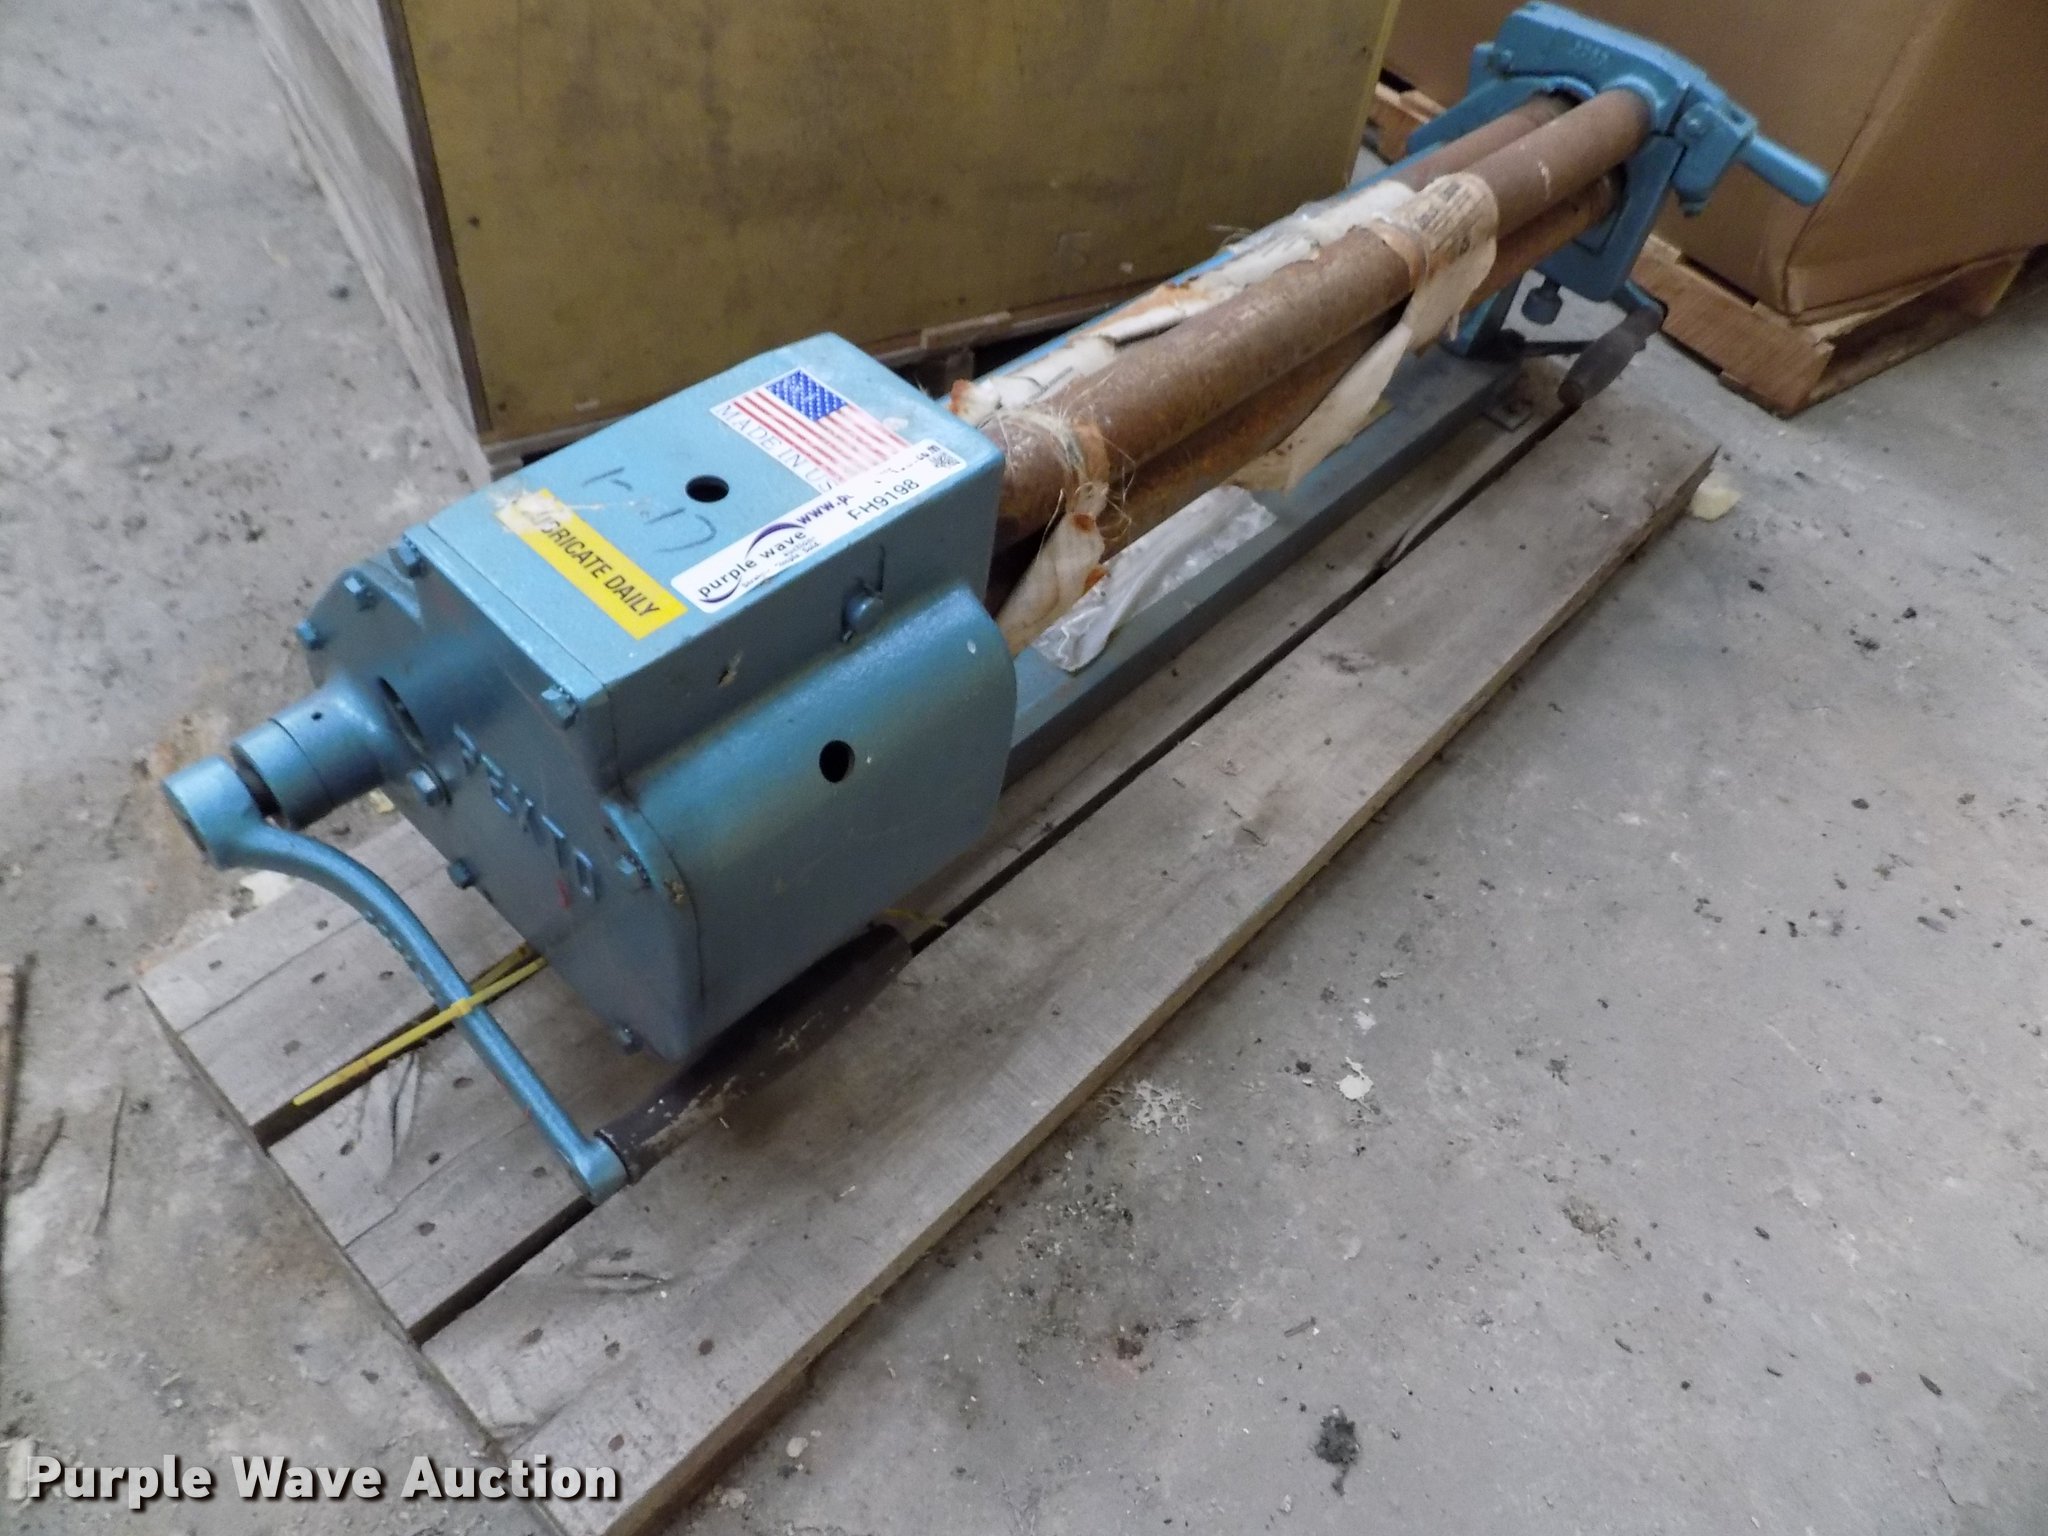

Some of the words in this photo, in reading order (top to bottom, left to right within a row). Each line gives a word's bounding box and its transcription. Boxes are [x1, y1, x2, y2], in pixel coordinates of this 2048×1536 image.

[717, 405, 781, 450] MADE
[778, 448, 807, 468] IN
[848, 478, 919, 521] FH9198
[518, 503, 612, 579] UBRICATE
[604, 576, 661, 617] DAILY
[698, 558, 757, 598] purple
[759, 531, 806, 559] wave
